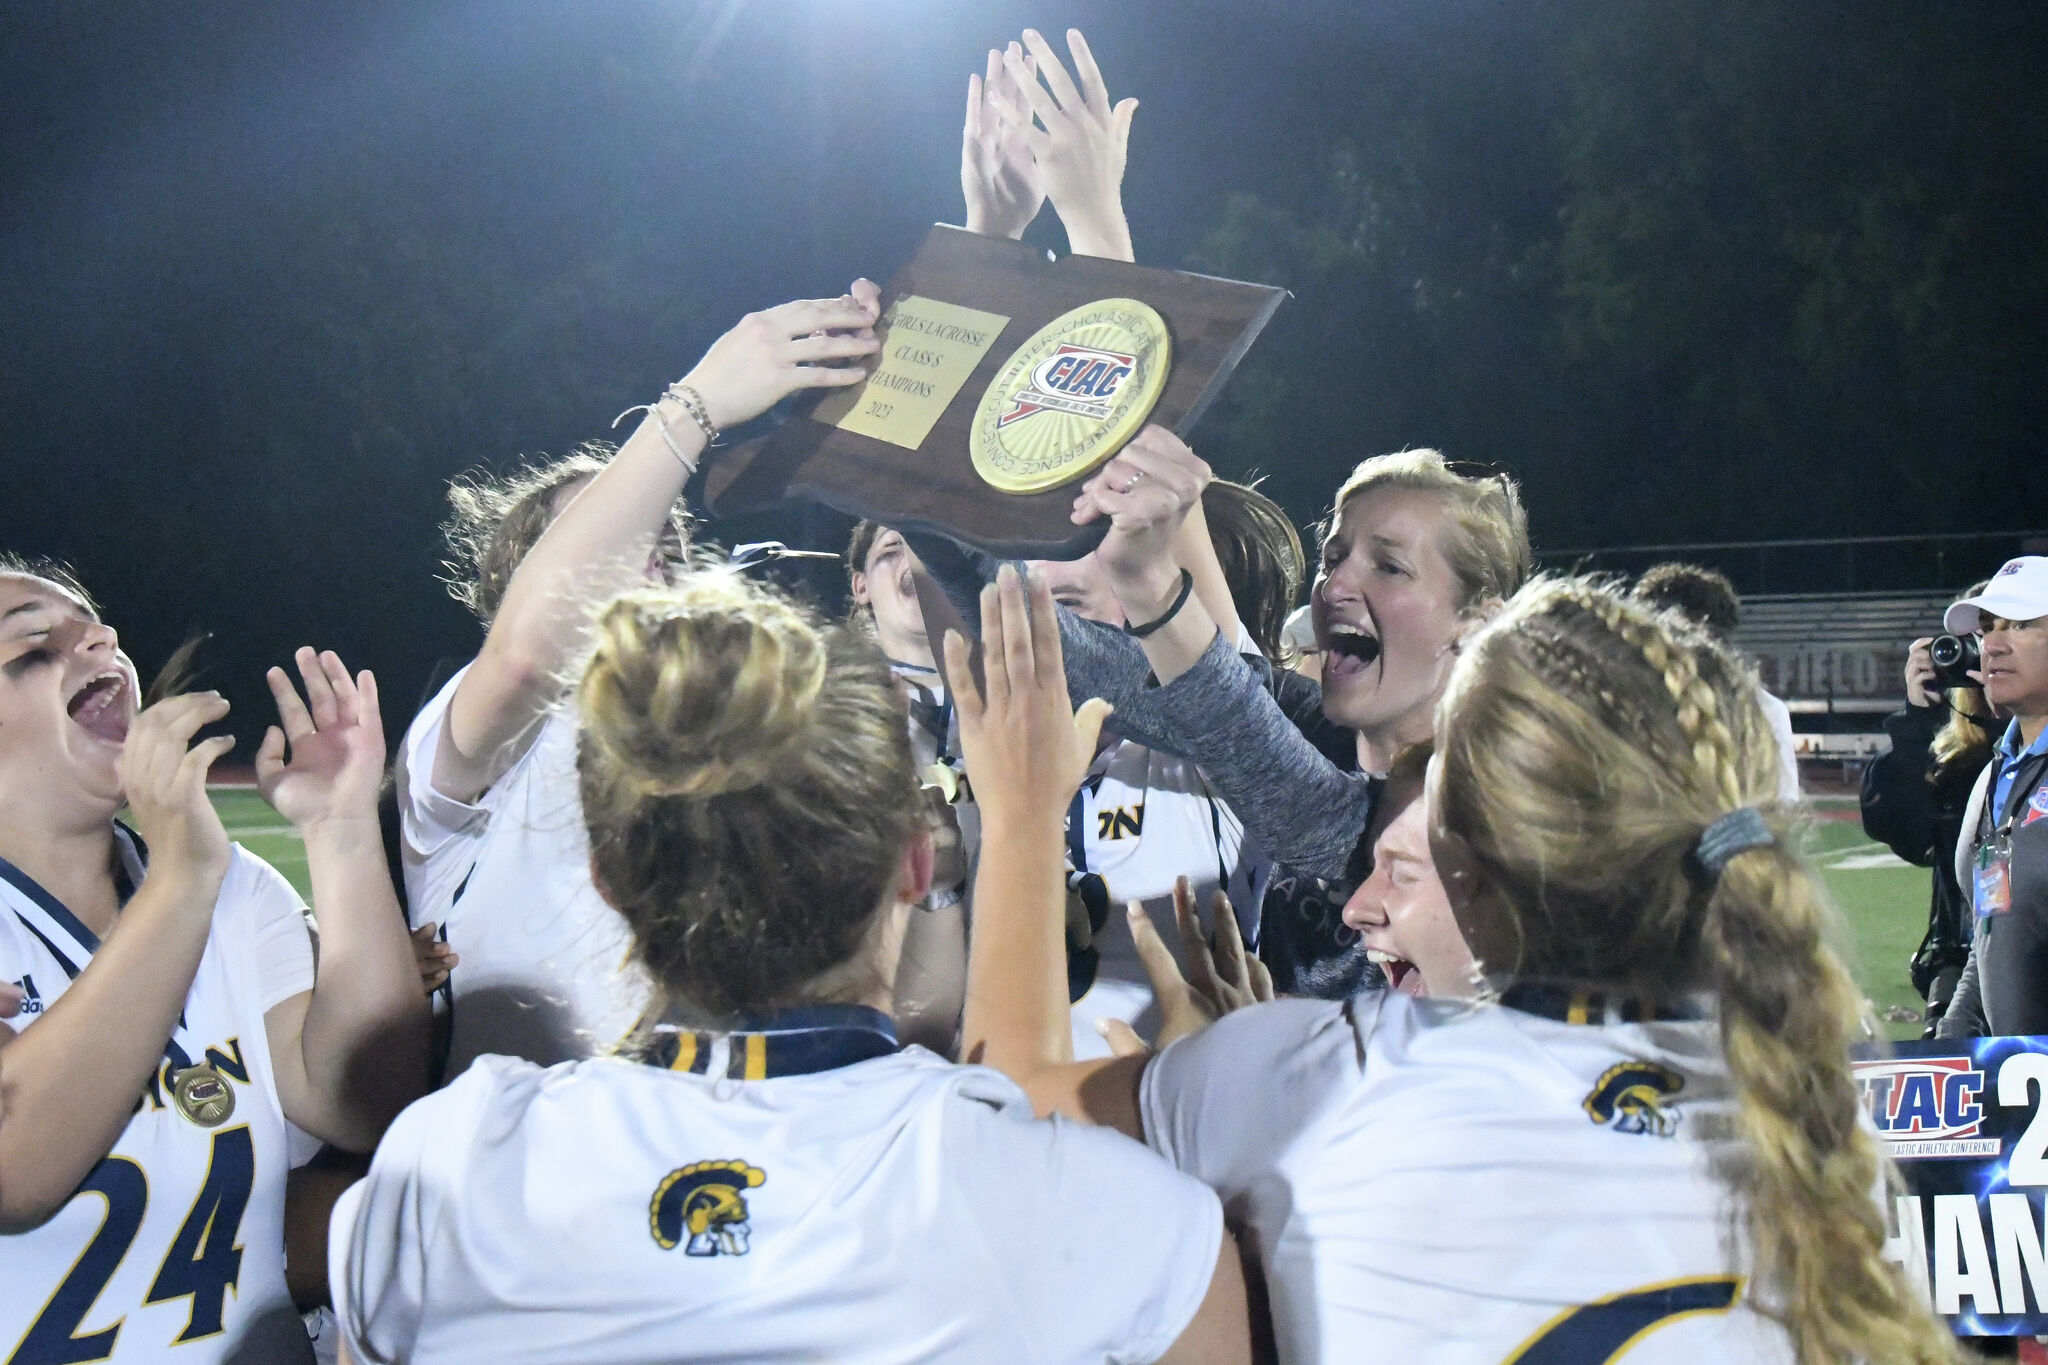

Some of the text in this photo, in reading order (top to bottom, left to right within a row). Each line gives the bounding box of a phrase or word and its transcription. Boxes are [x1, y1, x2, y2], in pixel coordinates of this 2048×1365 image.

[894, 313, 989, 347] GIRLS LACROSSE
[894, 345, 944, 368] CLASS S
[1045, 355, 1132, 397] CIAC
[865, 401, 893, 419] 2023
[1858, 1071, 1984, 1132] IAC
[1917, 1142, 1949, 1154] ATHLETIC
[1950, 1141, 1997, 1153] CONFERENCE
[5, 1124, 256, 1365] 24
